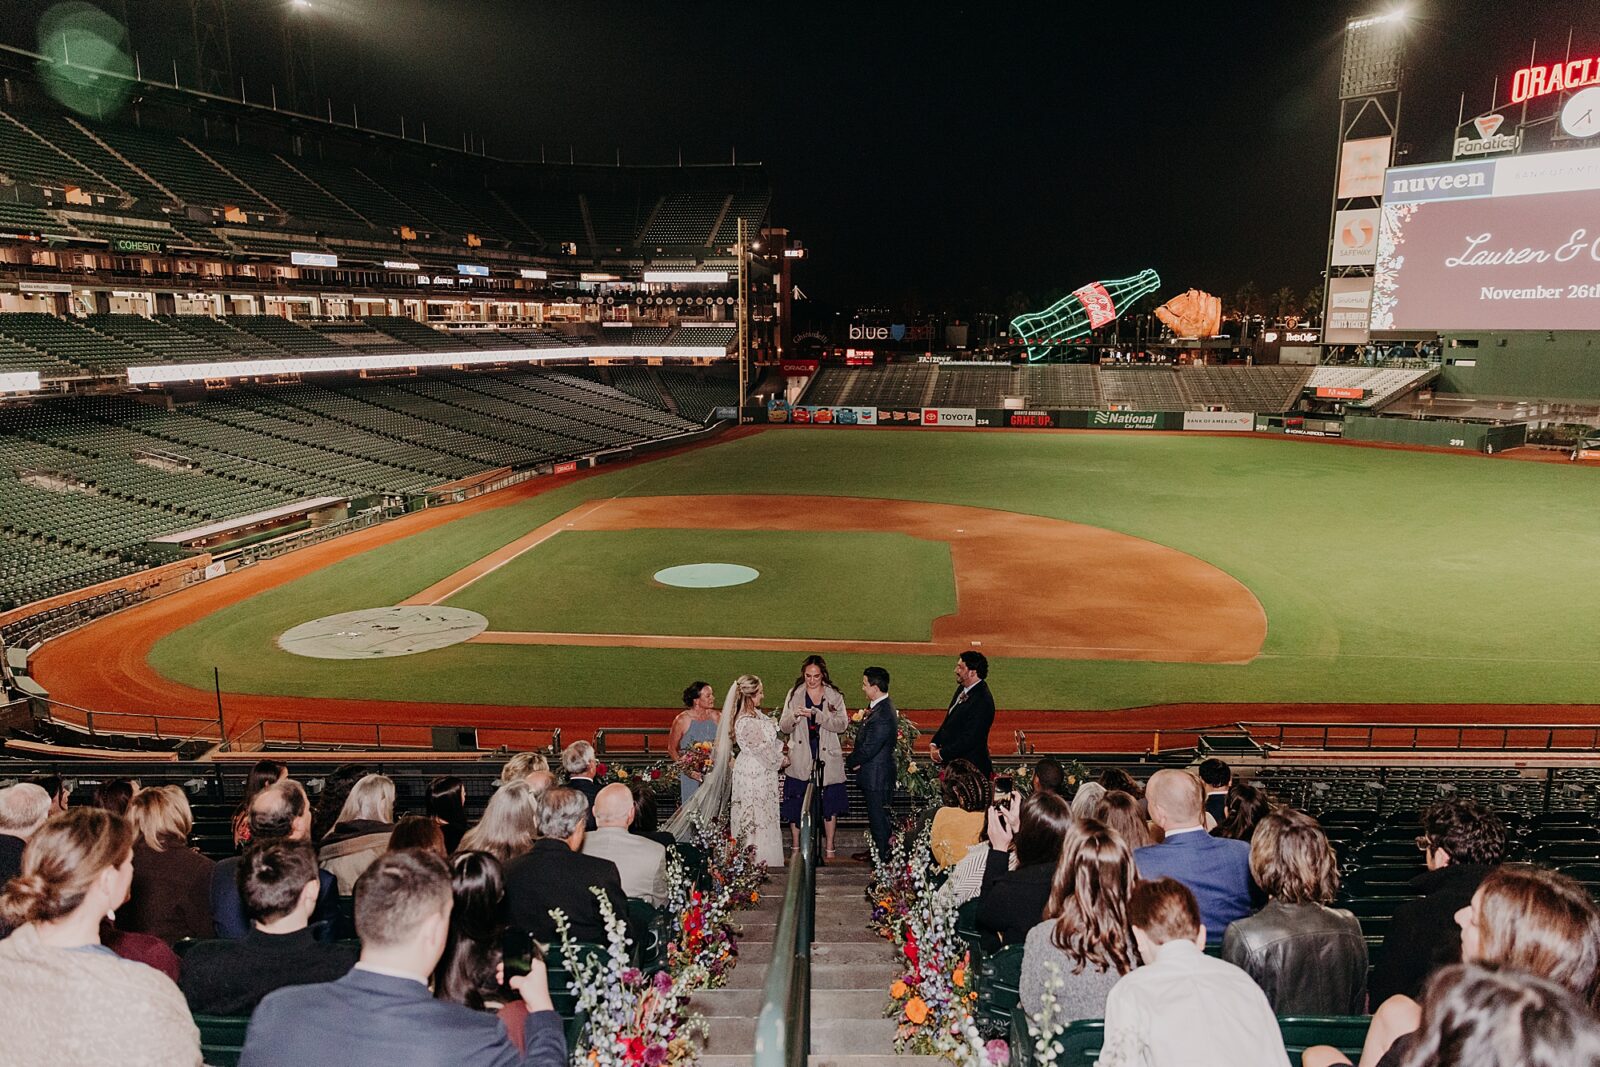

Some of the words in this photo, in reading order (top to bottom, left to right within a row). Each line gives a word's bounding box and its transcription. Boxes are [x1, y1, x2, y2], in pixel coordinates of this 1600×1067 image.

[1456, 134, 1515, 153] Fanatics
[1391, 171, 1485, 194] nuveen
[119, 239, 161, 251] COHESITY
[1445, 232, 1551, 268] Lauren
[1554, 228, 1588, 262] &
[1340, 248, 1372, 257] SAFEWAY
[1480, 285, 1563, 300] November
[849, 323, 889, 340] blue
[783, 364, 815, 372] ORACLE
[941, 413, 974, 421] TOYOTA
[1010, 415, 1036, 425] GAME
[1038, 415, 1051, 426] UP
[1109, 412, 1157, 424] National
[1449, 438, 1464, 446] 391
